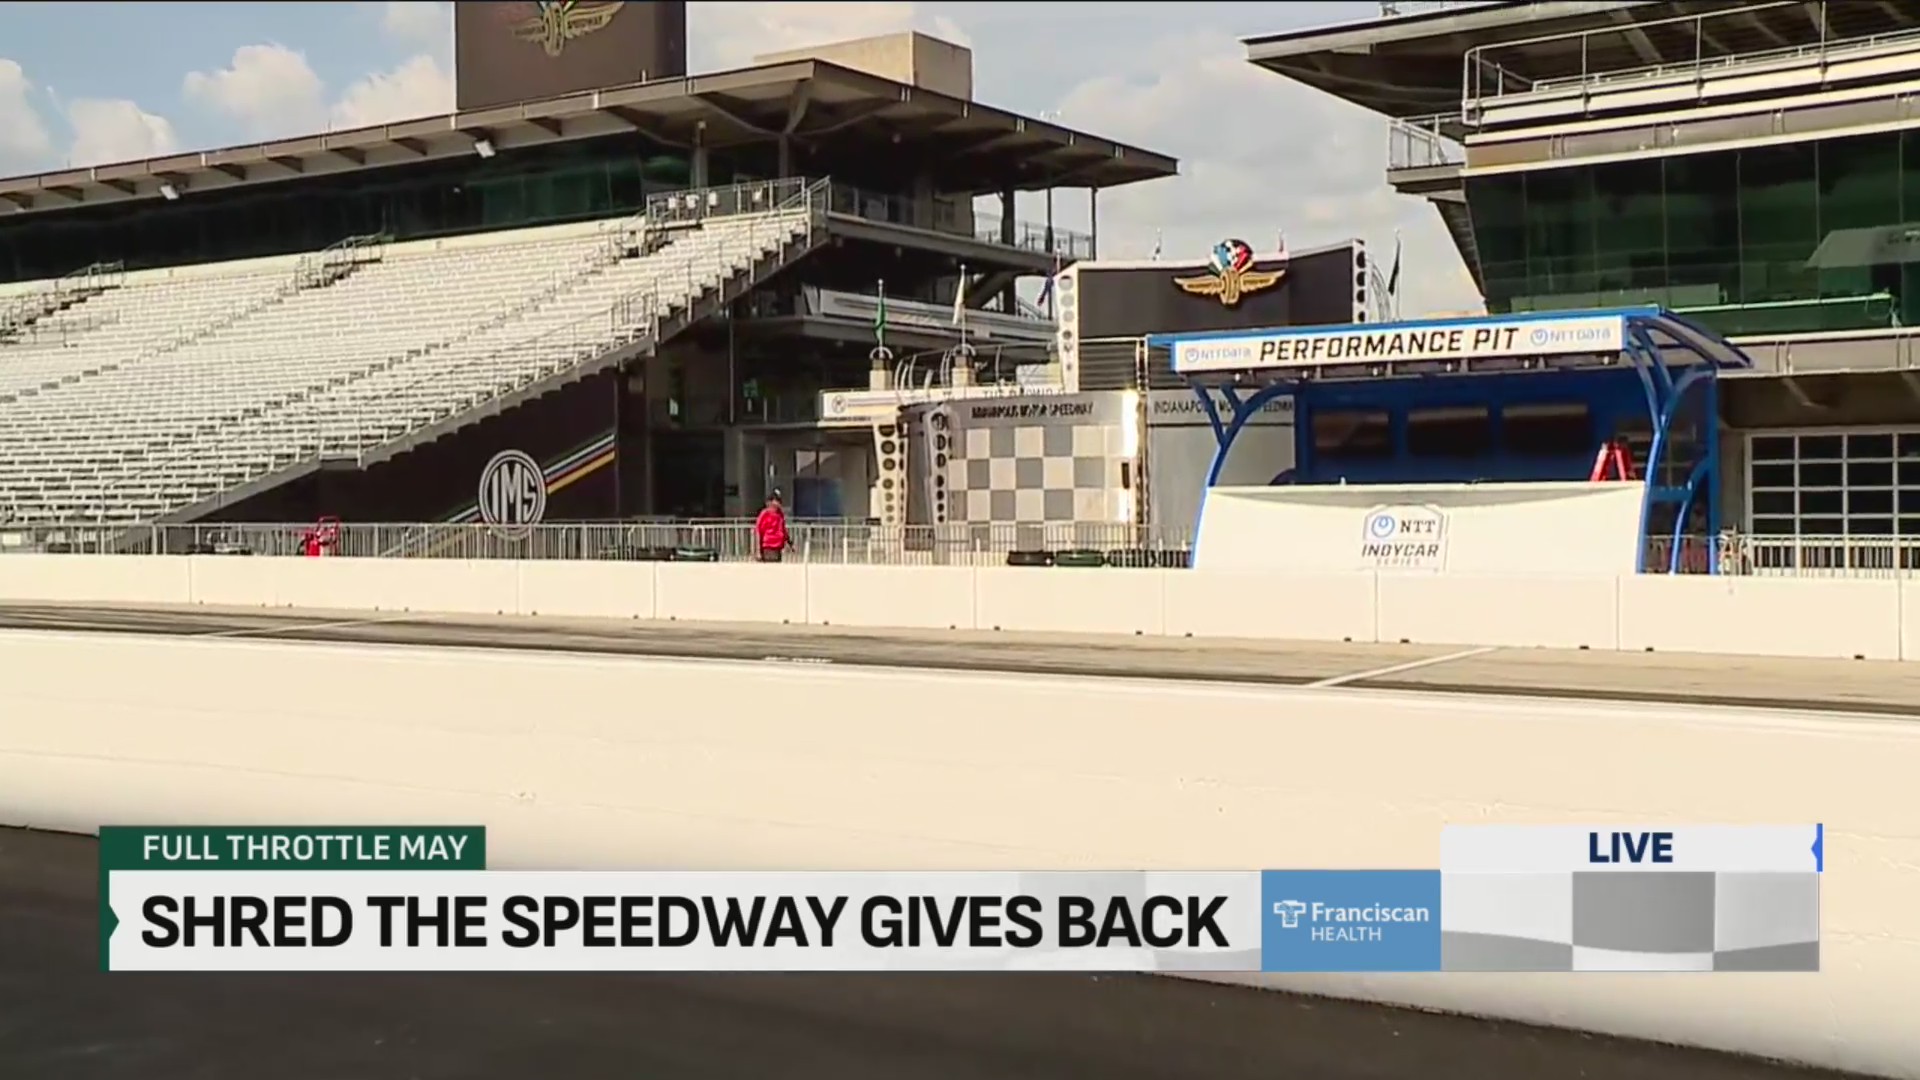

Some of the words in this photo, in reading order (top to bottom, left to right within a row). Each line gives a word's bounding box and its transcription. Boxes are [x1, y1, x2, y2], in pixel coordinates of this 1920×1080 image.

[1260, 330, 1463, 361] PERFORMANCE
[1473, 327, 1519, 351] PIT
[491, 462, 537, 524] IMS
[1400, 519, 1436, 533] NTT
[1361, 543, 1439, 557] INDYCAR
